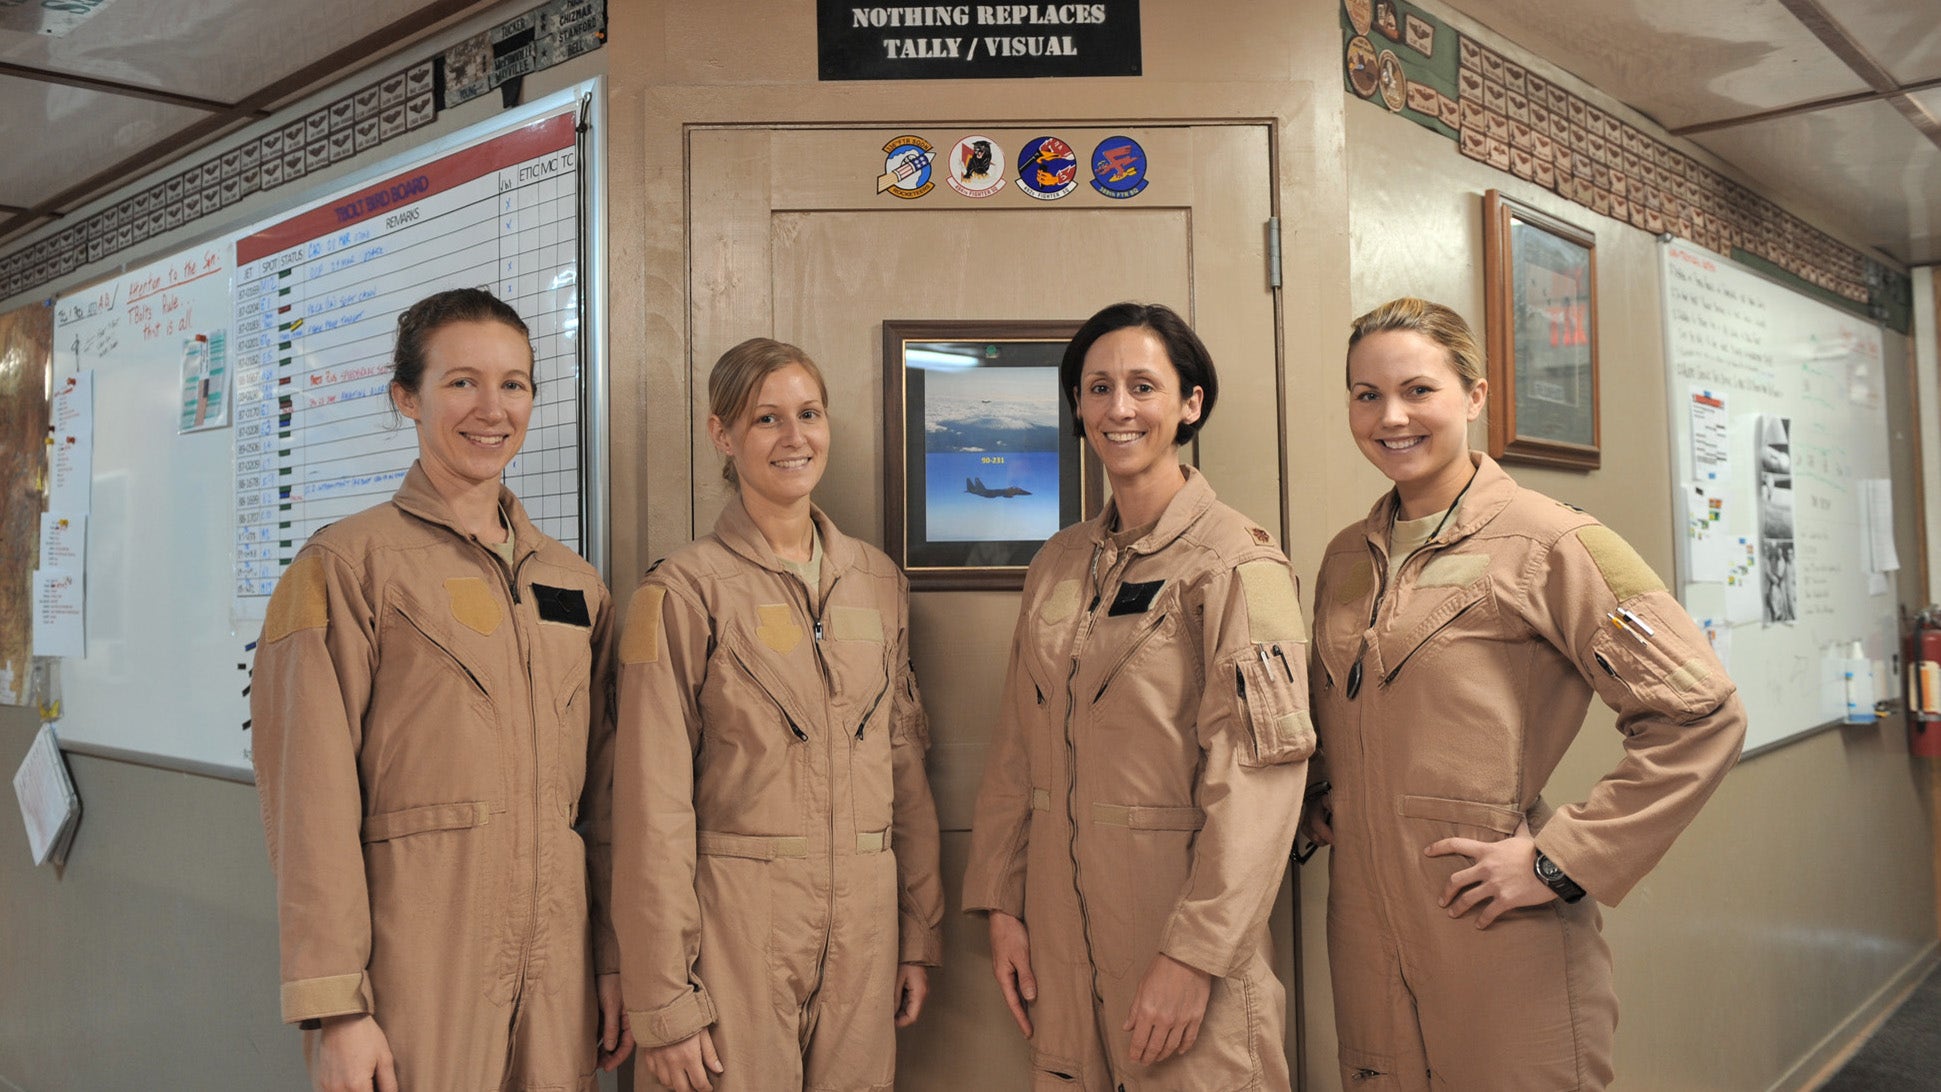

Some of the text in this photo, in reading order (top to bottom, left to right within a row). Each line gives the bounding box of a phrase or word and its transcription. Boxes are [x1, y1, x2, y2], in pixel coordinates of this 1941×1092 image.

[559, 4, 592, 26] CHIZMAR
[852, 4, 1106, 28] NOTHING REPLACES
[501, 18, 526, 38] TUCKER
[558, 16, 597, 43] STANFORD
[883, 36, 1078, 61] TALLY / VISUAL
[391, 175, 429, 202] BOARD
[262, 257, 278, 273] SPOT
[281, 250, 304, 266] STATUS
[385, 207, 420, 229] REMARKS
[519, 163, 539, 181] ETIC
[540, 158, 558, 176] MC
[561, 152, 574, 168] TC
[178, 307, 192, 332] all
[981, 456, 1005, 465] 90-231
